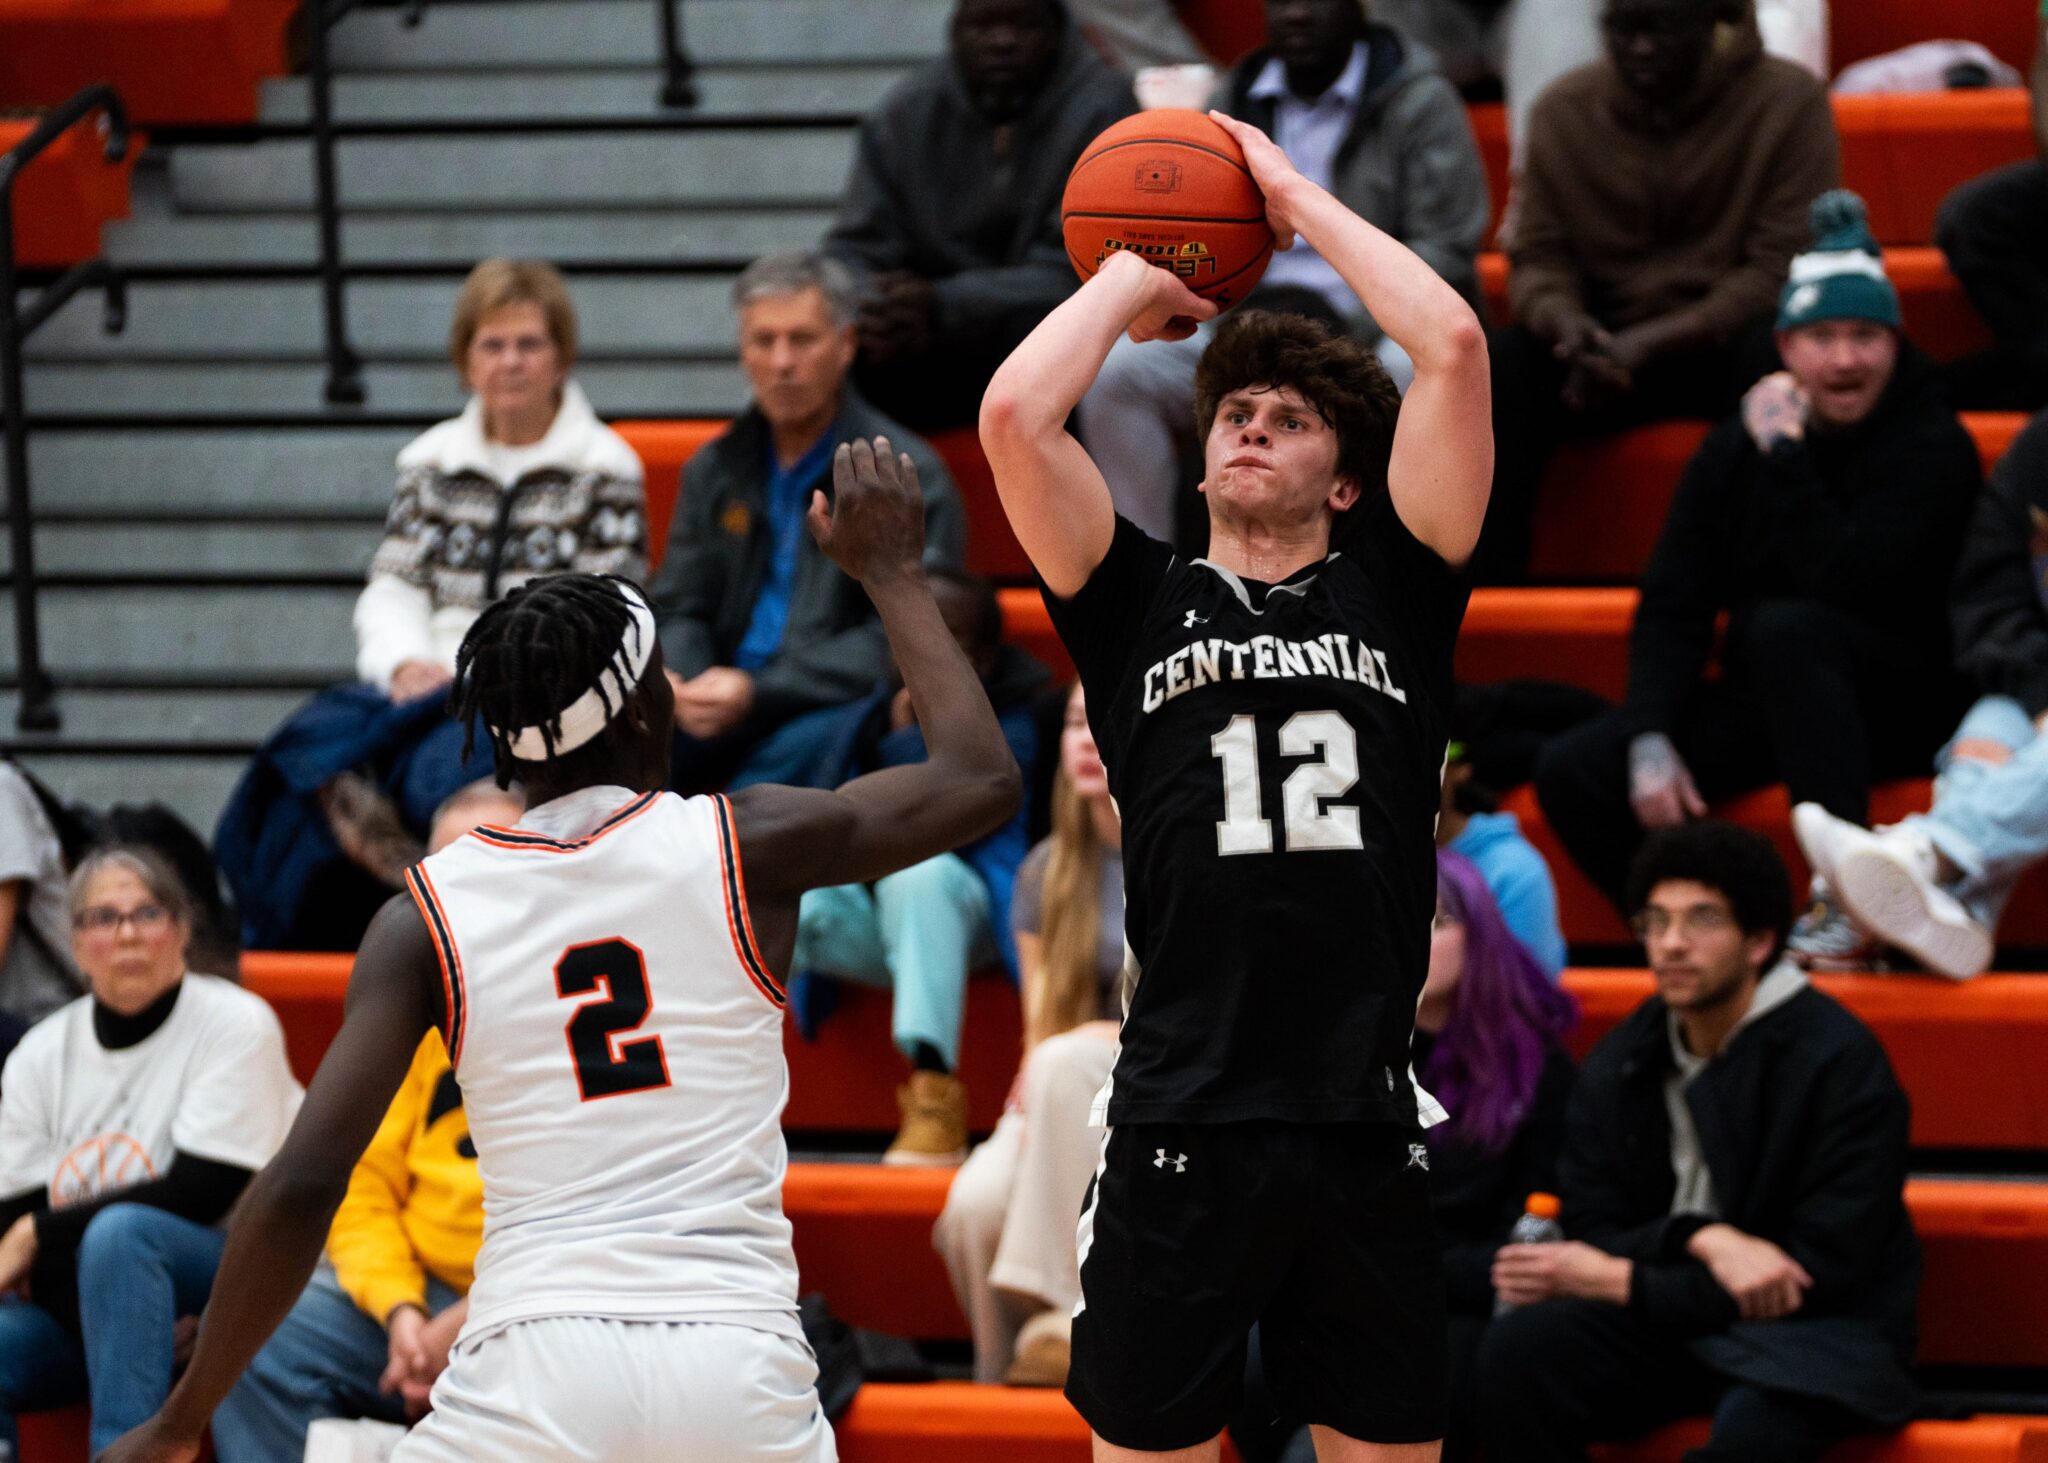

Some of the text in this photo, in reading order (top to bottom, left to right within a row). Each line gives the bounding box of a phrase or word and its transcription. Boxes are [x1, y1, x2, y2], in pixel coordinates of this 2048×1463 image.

[1104, 239, 1178, 256] 1000
[1142, 633, 1407, 714] CENTENNIAL
[1211, 709, 1364, 856] 12
[553, 935, 672, 1102] 2
